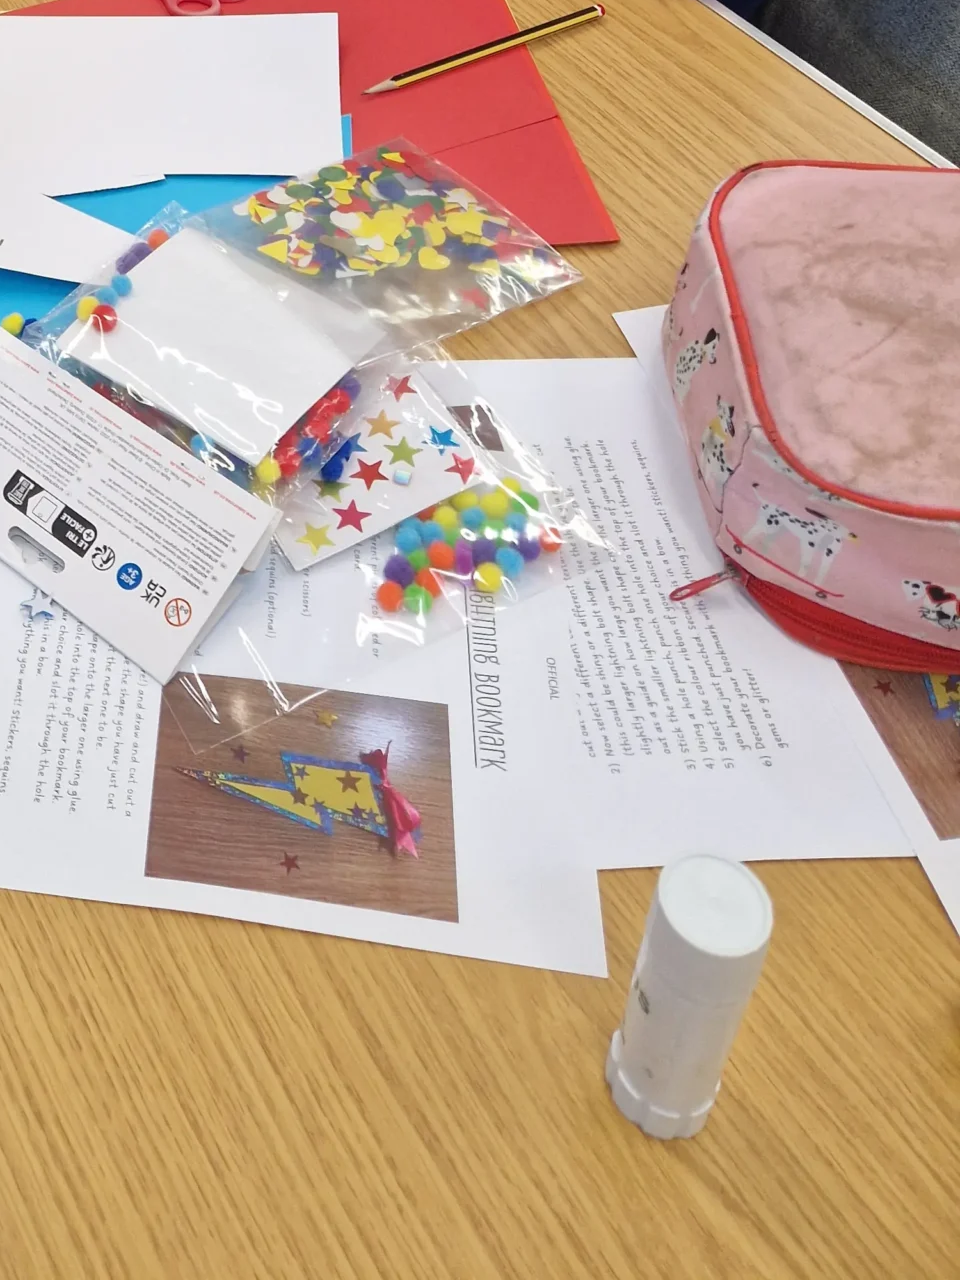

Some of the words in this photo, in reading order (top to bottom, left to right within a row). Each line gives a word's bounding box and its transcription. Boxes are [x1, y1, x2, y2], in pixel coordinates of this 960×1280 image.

[563, 435, 580, 454] glue.
[595, 439, 610, 457] hole
[630, 439, 648, 470] sequins,
[571, 455, 584, 477] using
[579, 440, 604, 484] bookmark.
[603, 458, 616, 473] the
[579, 479, 591, 495] one
[599, 485, 617, 505] your
[609, 473, 631, 509] through
[643, 471, 663, 507] Stickers,
[586, 496, 602, 522] larger
[603, 506, 617, 517] of
[623, 510, 634, 518] it
[60, 512, 85, 533] FACILE
[612, 518, 625, 535] top
[627, 520, 641, 537] slot
[656, 508, 674, 534] want!
[65, 530, 79, 544] TRI
[596, 524, 608, 540] the
[77, 539, 89, 550] LE
[568, 542, 581, 558] the
[617, 536, 631, 556] the
[633, 538, 650, 558] and
[654, 536, 666, 557] bow.
[671, 536, 687, 552] you
[351, 548, 362, 572] card.
[576, 560, 586, 575] Use
[589, 551, 601, 566] the
[624, 554, 638, 573] into
[119, 572, 136, 586] AGE
[127, 567, 139, 579] 3+
[265, 557, 278, 589] sequins
[594, 568, 611, 593] want
[612, 565, 628, 592] shape
[645, 560, 662, 589] choice
[665, 567, 675, 578] in
[583, 578, 599, 607] shape.
[632, 575, 648, 595] hole
[140, 588, 160, 608] UK
[300, 580, 312, 617] scissors)
[565, 584, 588, 628] different
[607, 595, 623, 612] you
[621, 594, 636, 614] bolt
[642, 597, 655, 615] one
[657, 591, 681, 612] your
[263, 591, 279, 639] (optional)
[591, 609, 606, 629] bolt
[662, 614, 679, 626] of
[676, 600, 697, 630] Secure
[693, 599, 711, 621] with
[613, 614, 628, 639] large
[647, 616, 673, 648] punch
[40, 633, 50, 644] in
[55, 624, 70, 655] choice
[586, 640, 596, 651] or
[632, 616, 657, 662] lightning
[673, 628, 692, 662] ribbon
[704, 624, 733, 674] bookmark
[71, 643, 83, 664] into
[371, 647, 379, 659] or
[602, 631, 626, 678] lightning
[623, 641, 637, 661] how
[691, 633, 723, 679] punched.
[16, 656, 28, 675] you
[35, 656, 49, 677] bow.
[52, 657, 63, 678] and
[68, 665, 81, 684] the
[86, 656, 97, 680] onto
[104, 655, 117, 673] the
[591, 653, 607, 681] shiny
[632, 663, 642, 677] on
[661, 650, 688, 685] punch,
[101, 675, 112, 697] next
[120, 668, 132, 685] the
[545, 656, 561, 701] OFFICIAL
[650, 664, 671, 702] smaller
[687, 664, 706, 696] colour
[741, 668, 770, 704] glitter!
[13, 677, 24, 707] want!
[48, 680, 62, 700] slot
[61, 686, 78, 704] top
[83, 682, 96, 700] the
[601, 683, 612, 696] be
[619, 681, 637, 712] larger
[635, 680, 659, 708] guide
[676, 687, 693, 710] hole
[709, 681, 732, 703] just
[729, 676, 750, 700] your
[47, 701, 58, 711] it
[99, 699, 108, 718] one
[113, 688, 130, 717] shape
[136, 689, 147, 710] and
[701, 699, 714, 717] the
[61, 706, 76, 719] of
[76, 702, 94, 733] larger
[587, 701, 606, 732] select
[603, 699, 624, 728] could
[665, 705, 679, 724] the
[722, 703, 739, 729] have
[761, 707, 772, 719] or
[4, 709, 21, 752] Stickers,
[37, 712, 57, 756] through
[58, 719, 70, 744] your
[97, 720, 109, 732] to
[111, 719, 123, 738] you
[133, 712, 145, 739] draw
[630, 715, 653, 756] slightly
[653, 721, 663, 734] as
[706, 720, 728, 752] Select
[739, 702, 767, 750] Decorate
[767, 722, 790, 749] gems
[76, 736, 86, 756] one
[95, 735, 108, 750] be.
[601, 734, 616, 757] Now
[618, 731, 635, 757] (this
[656, 736, 672, 755] out
[671, 726, 690, 754] Stick
[692, 723, 709, 753] Using
[734, 731, 753, 751] you
[111, 741, 125, 766] have
[130, 741, 141, 764] and
[581, 740, 597, 758] cut
[37, 758, 50, 777] the
[607, 763, 621, 775] 2)
[683, 758, 697, 771] 3)
[702, 757, 716, 770] 4)
[721, 757, 735, 770] 5)
[758, 755, 773, 768] 6)
[51, 747, 71, 804] bookmark.
[67, 758, 83, 787] using
[106, 765, 119, 789] just
[127, 767, 138, 784] cut
[32, 780, 48, 804] hole
[66, 788, 82, 815] glue.
[105, 792, 117, 811] cut
[125, 788, 136, 807] out
[124, 810, 132, 818] a
